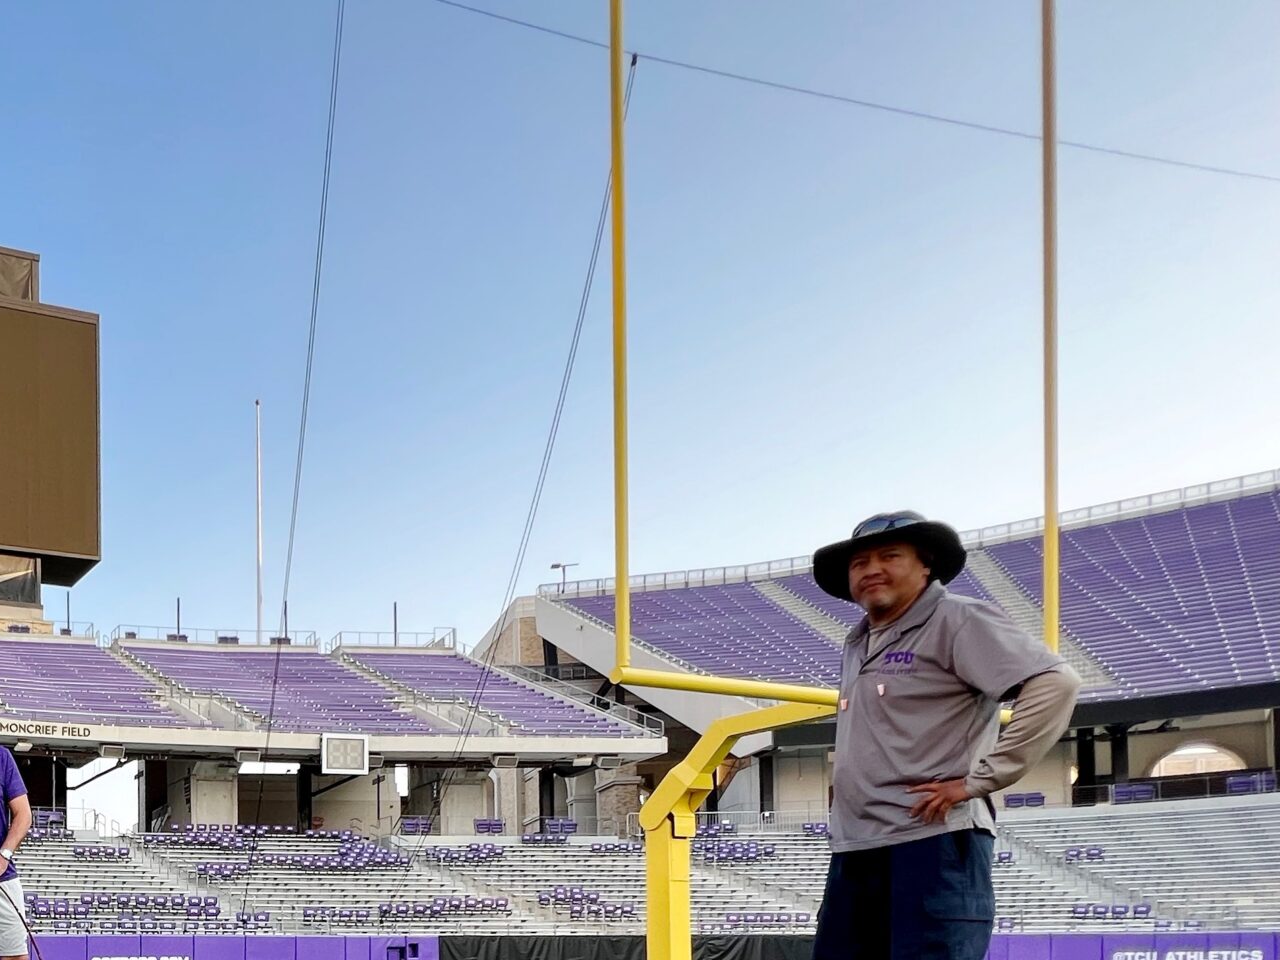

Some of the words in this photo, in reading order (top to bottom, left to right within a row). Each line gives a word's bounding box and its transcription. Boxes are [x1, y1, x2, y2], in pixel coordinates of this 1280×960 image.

[884, 651, 915, 665] TCU
[0, 722, 57, 735] MONCRIEF
[61, 726, 91, 737] FIELD
